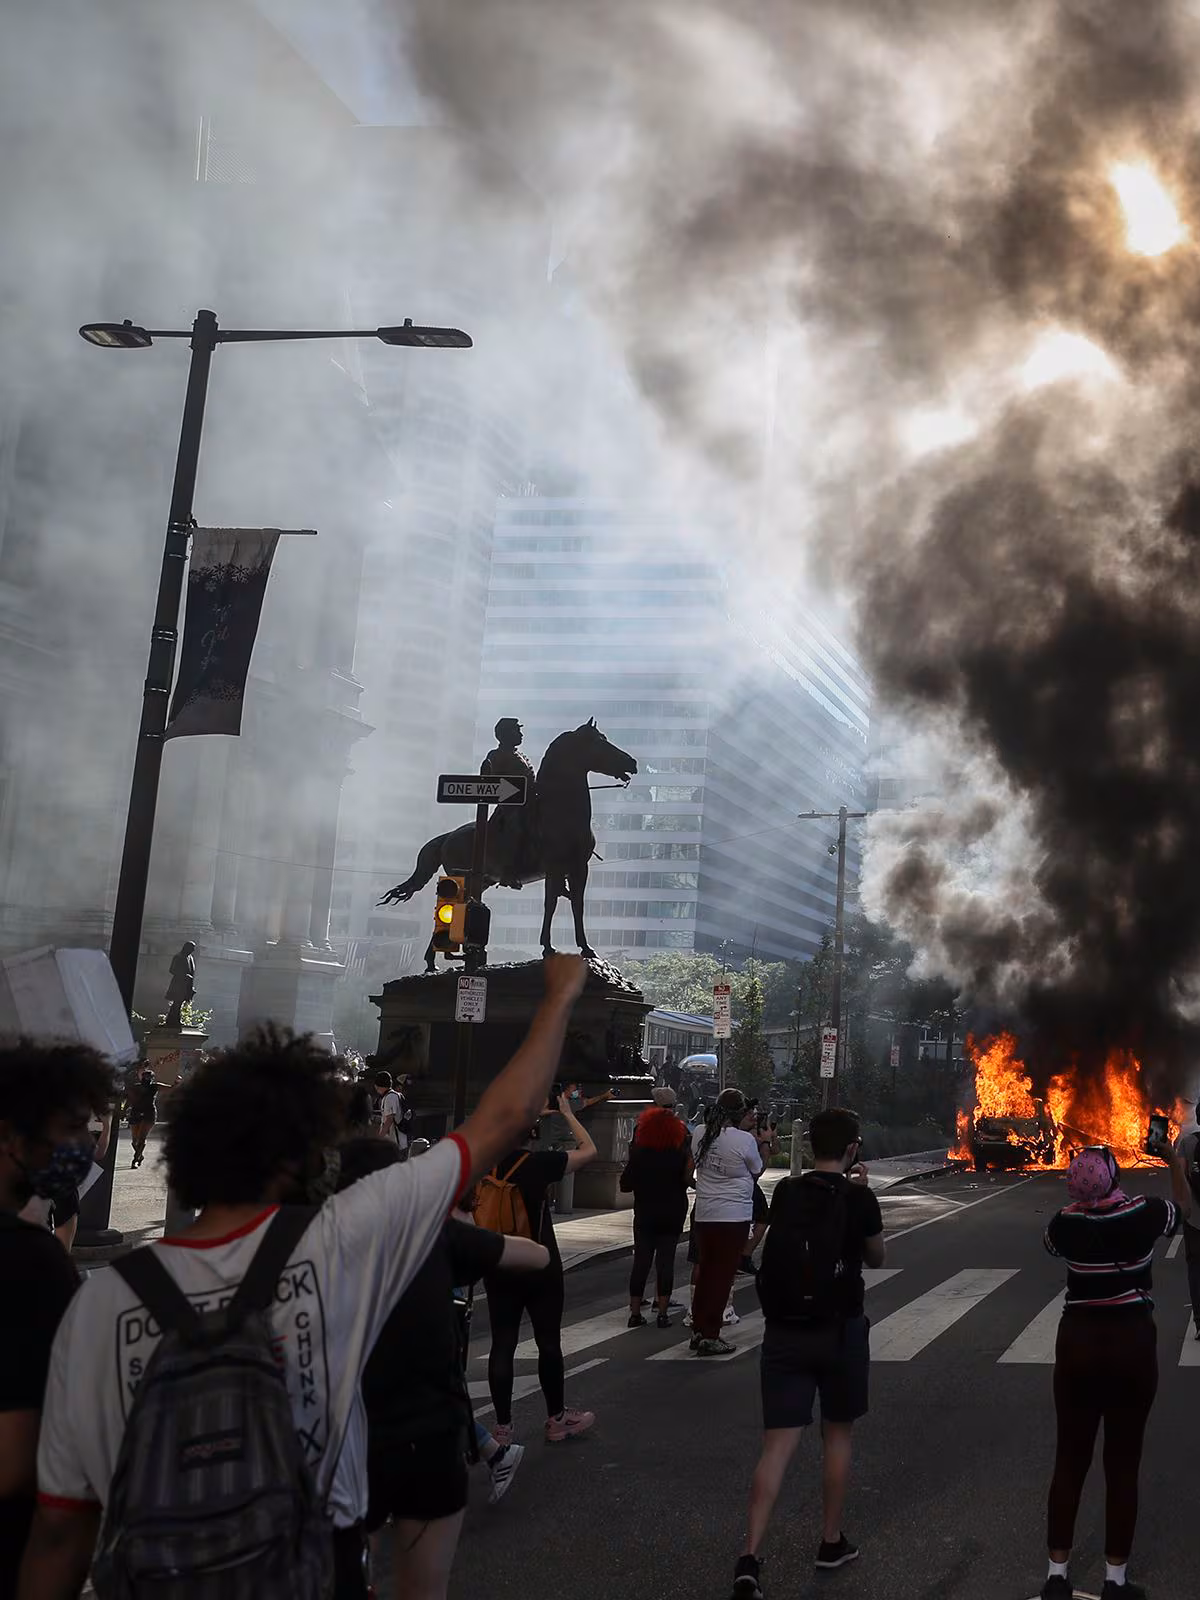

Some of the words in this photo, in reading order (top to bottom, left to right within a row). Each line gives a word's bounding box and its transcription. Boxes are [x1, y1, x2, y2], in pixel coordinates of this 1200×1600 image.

[447, 783, 472, 794] ONE
[477, 784, 499, 794] WAY
[459, 978, 469, 988] NO
[295, 1311, 316, 1409] CHUNK
